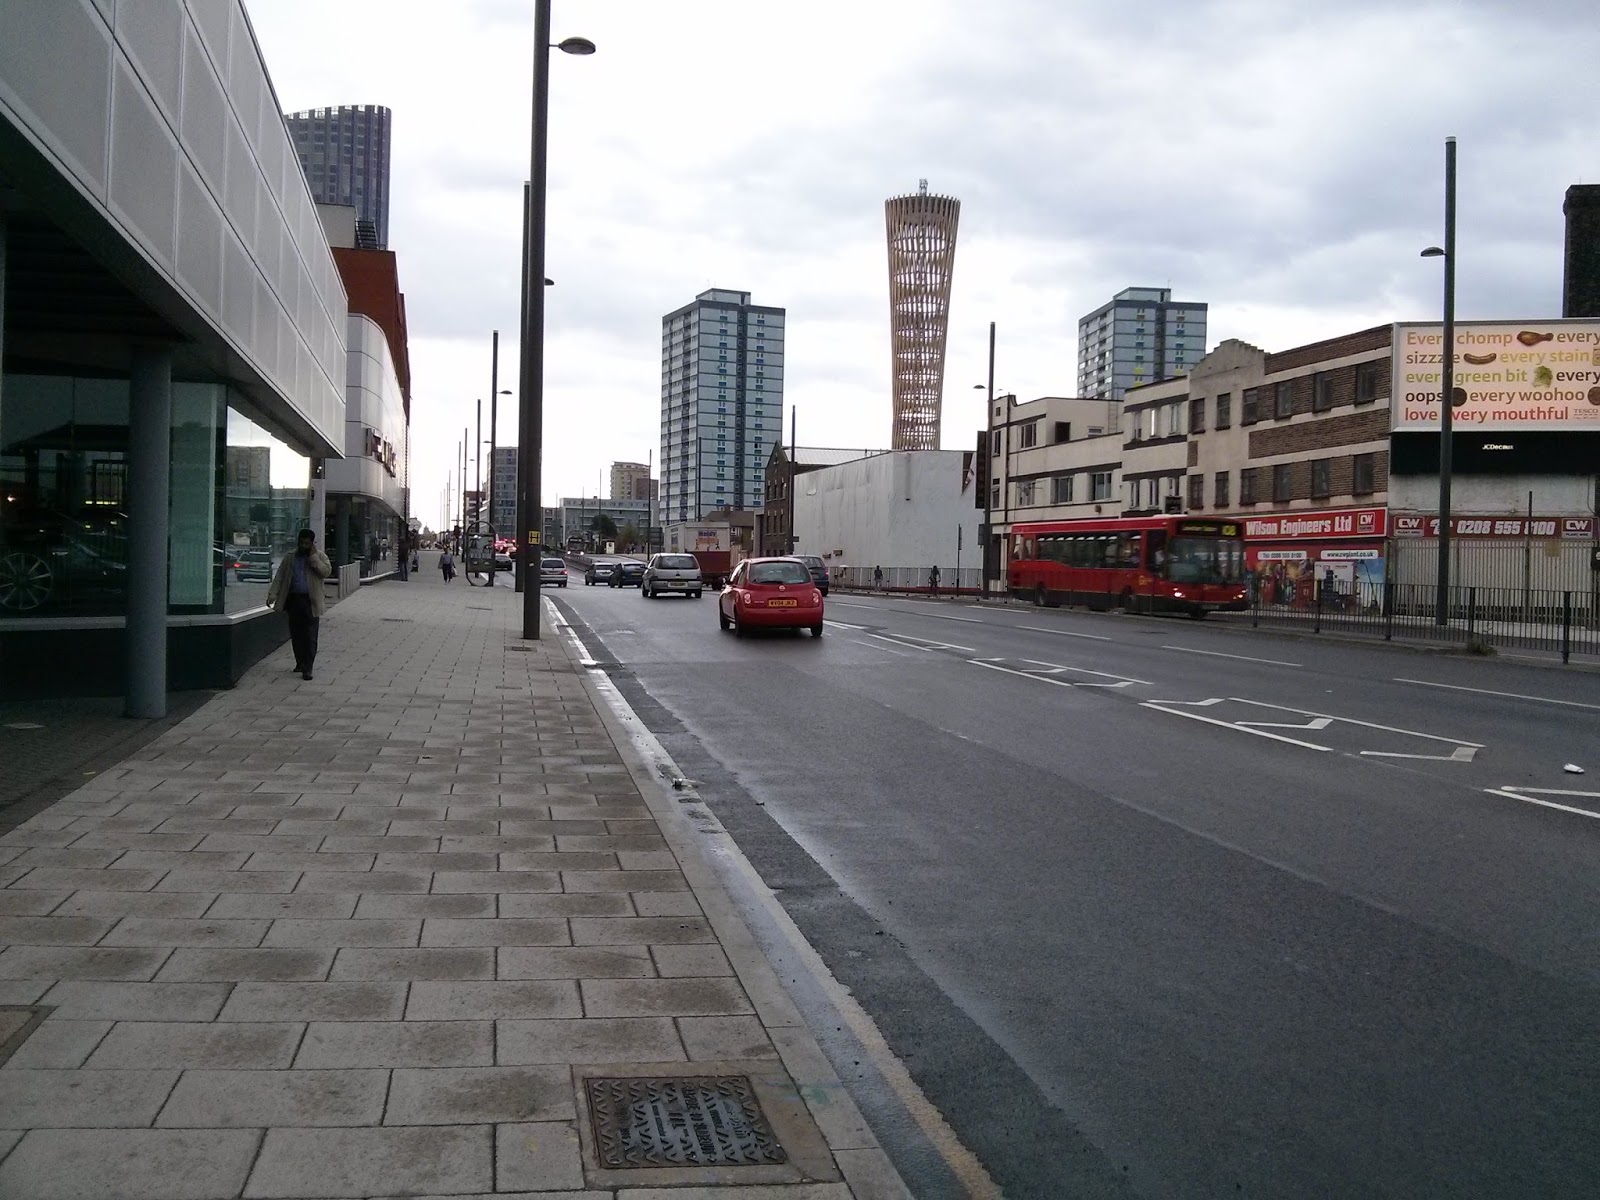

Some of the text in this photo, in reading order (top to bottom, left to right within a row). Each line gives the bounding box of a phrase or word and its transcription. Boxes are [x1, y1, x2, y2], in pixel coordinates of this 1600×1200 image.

[1407, 331, 1600, 346] Ever chomp every
[1406, 348, 1590, 366] sizzze every stain
[1406, 368, 1600, 386] ever green bit every
[1469, 391, 1516, 405] every
[1518, 387, 1585, 401] woohoo
[1404, 406, 1569, 424] love very mouthful
[1246, 515, 1352, 536] Wilson Engineers Ltd
[1398, 518, 1420, 529] CW
[1457, 520, 1491, 534] 0208
[1494, 520, 1522, 534] 555
[1565, 520, 1589, 530] CW
